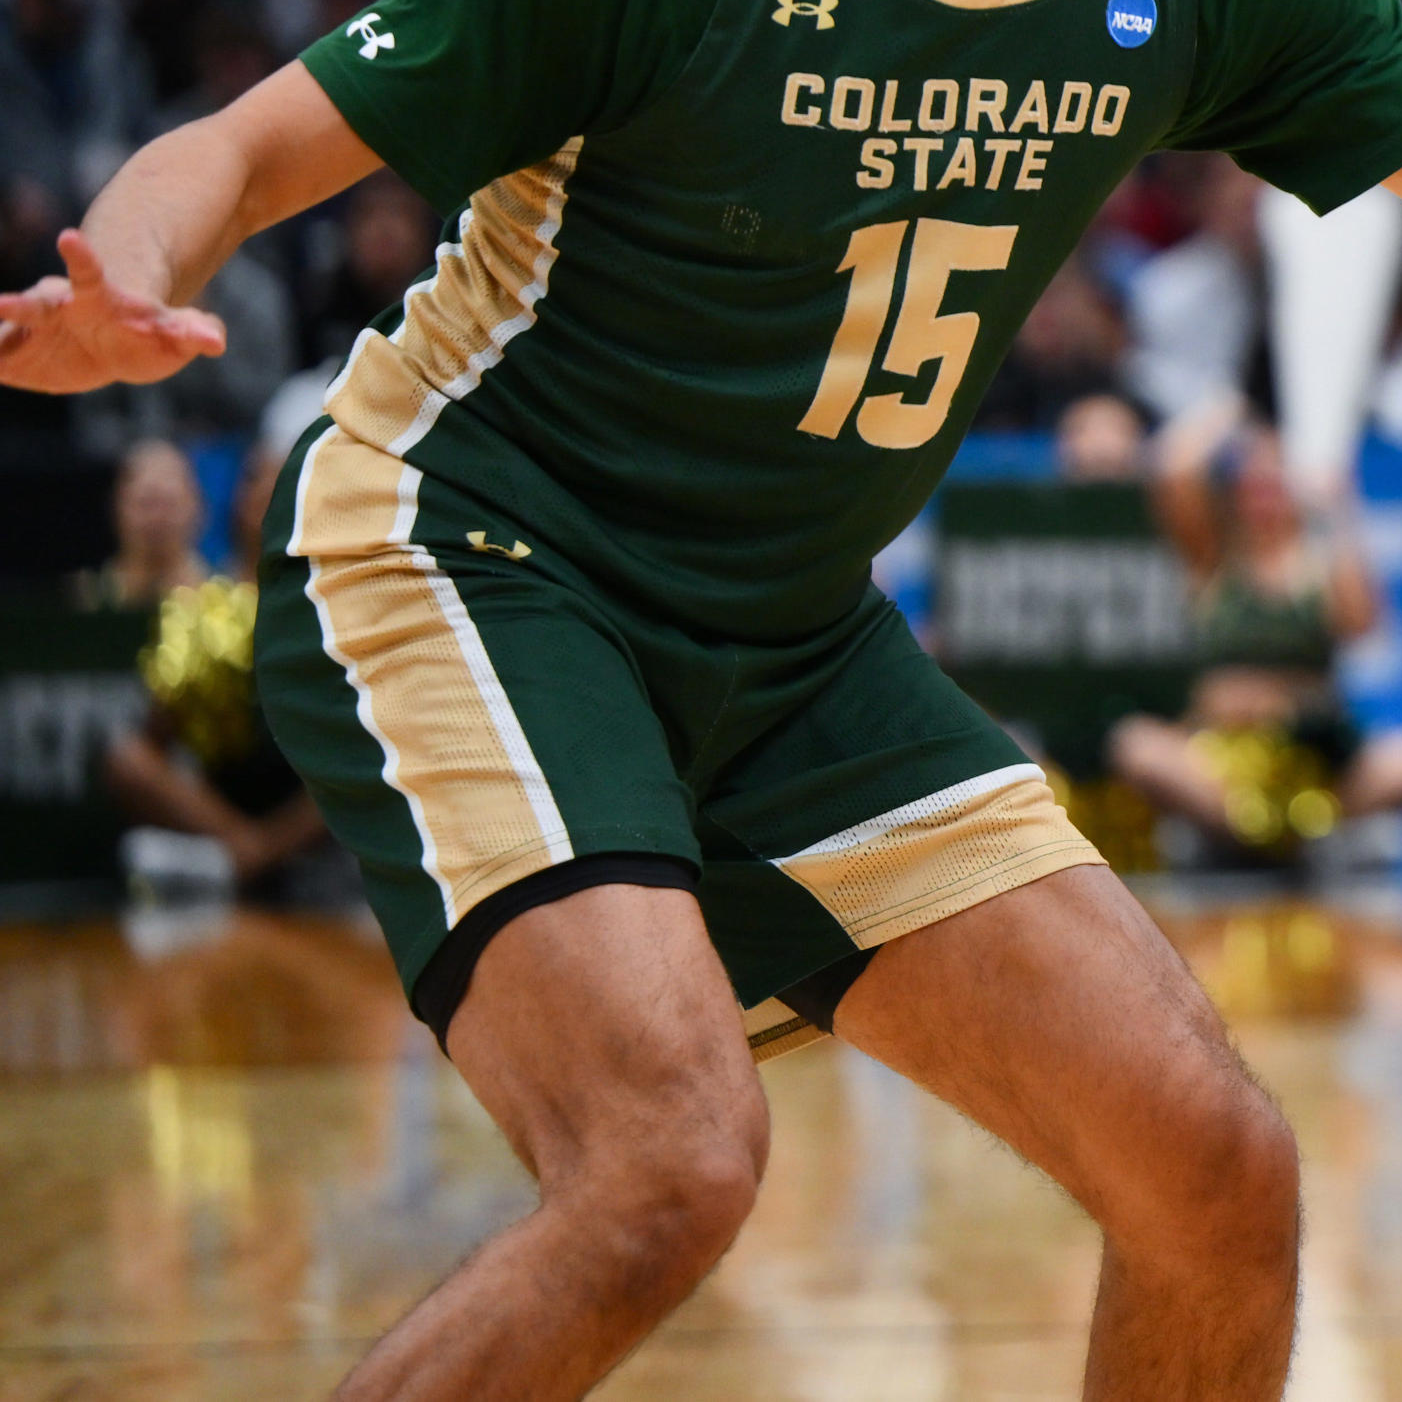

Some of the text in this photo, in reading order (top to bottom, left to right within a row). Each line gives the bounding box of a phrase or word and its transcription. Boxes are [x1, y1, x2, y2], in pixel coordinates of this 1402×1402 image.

[1111, 11, 1153, 35] NCAA
[781, 71, 1131, 137] COLORADO
[856, 137, 1054, 191] STATE
[796, 217, 1020, 450] 15
